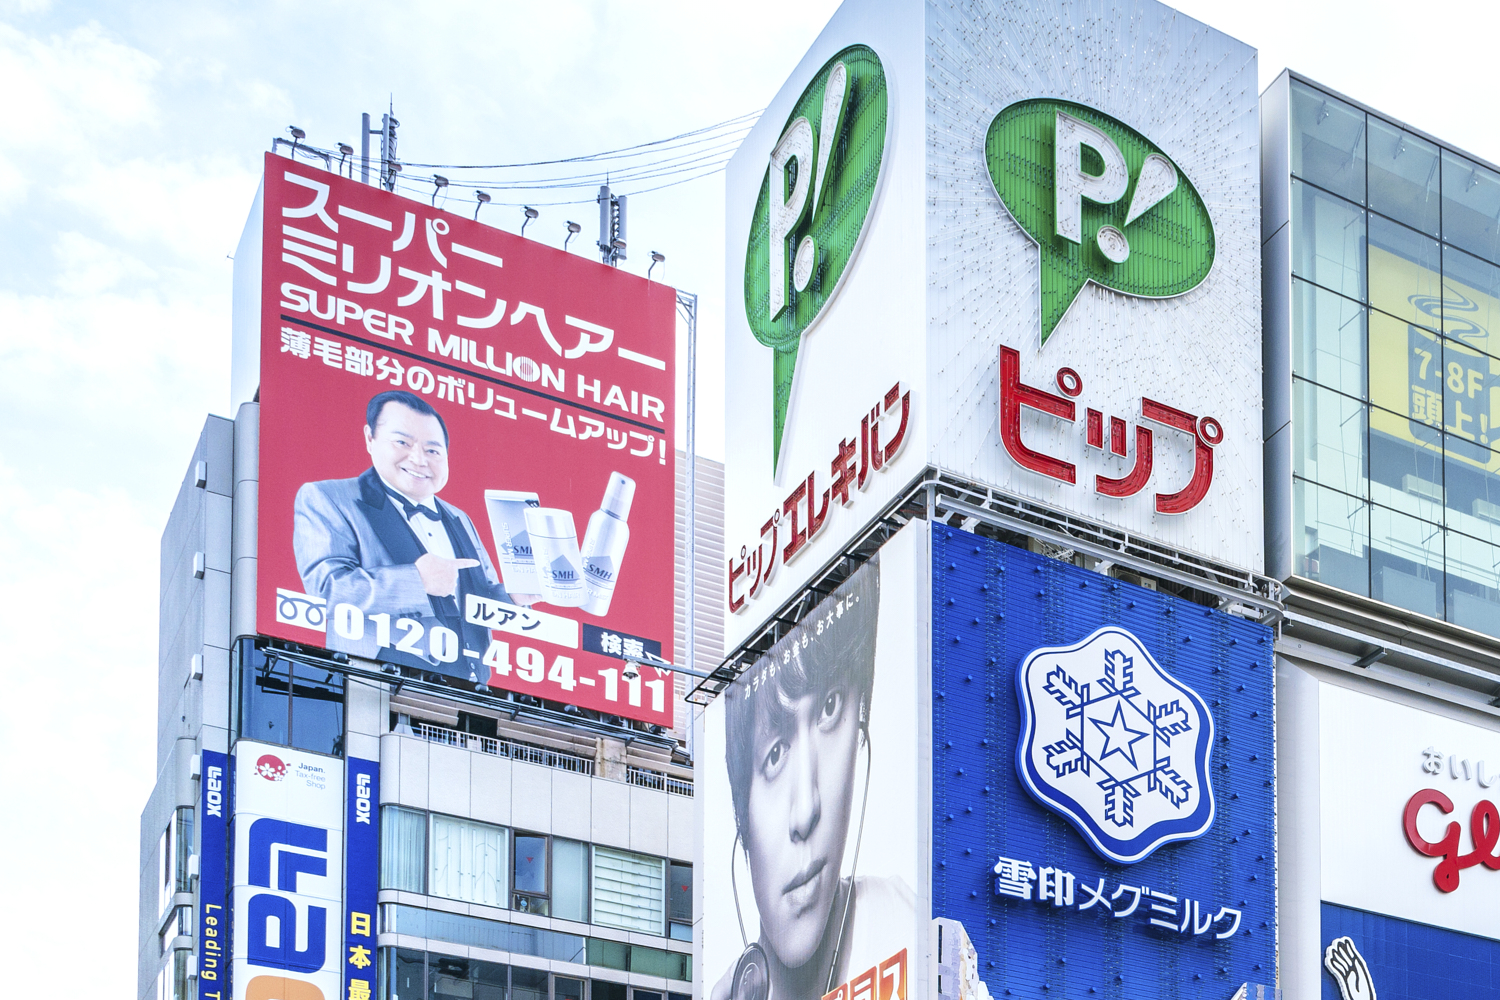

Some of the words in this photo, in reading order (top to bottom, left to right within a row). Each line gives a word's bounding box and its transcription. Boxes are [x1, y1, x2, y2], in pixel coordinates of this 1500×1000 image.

[281, 170, 503, 268] スーパー
[281, 224, 666, 371] ミリオンヘアー
[280, 281, 414, 345] SUPER
[427, 335, 565, 394] MILLION
[577, 375, 666, 422] HAIR
[999, 343, 1224, 516] ピップ
[1412, 385, 1489, 445] 頭上!
[727, 381, 914, 614] ピップエレキバン
[552, 569, 574, 580] SMH
[589, 563, 612, 580] SMH
[470, 600, 542, 632] ルアン
[600, 630, 645, 660] 検索
[332, 601, 666, 714] 0120-494-111
[295, 770, 326, 783] Tax-free
[298, 762, 326, 774] Japan.
[306, 779, 326, 790] Shop
[994, 856, 1242, 939] 雪印メグミルク
[201, 903, 222, 981] Leading
